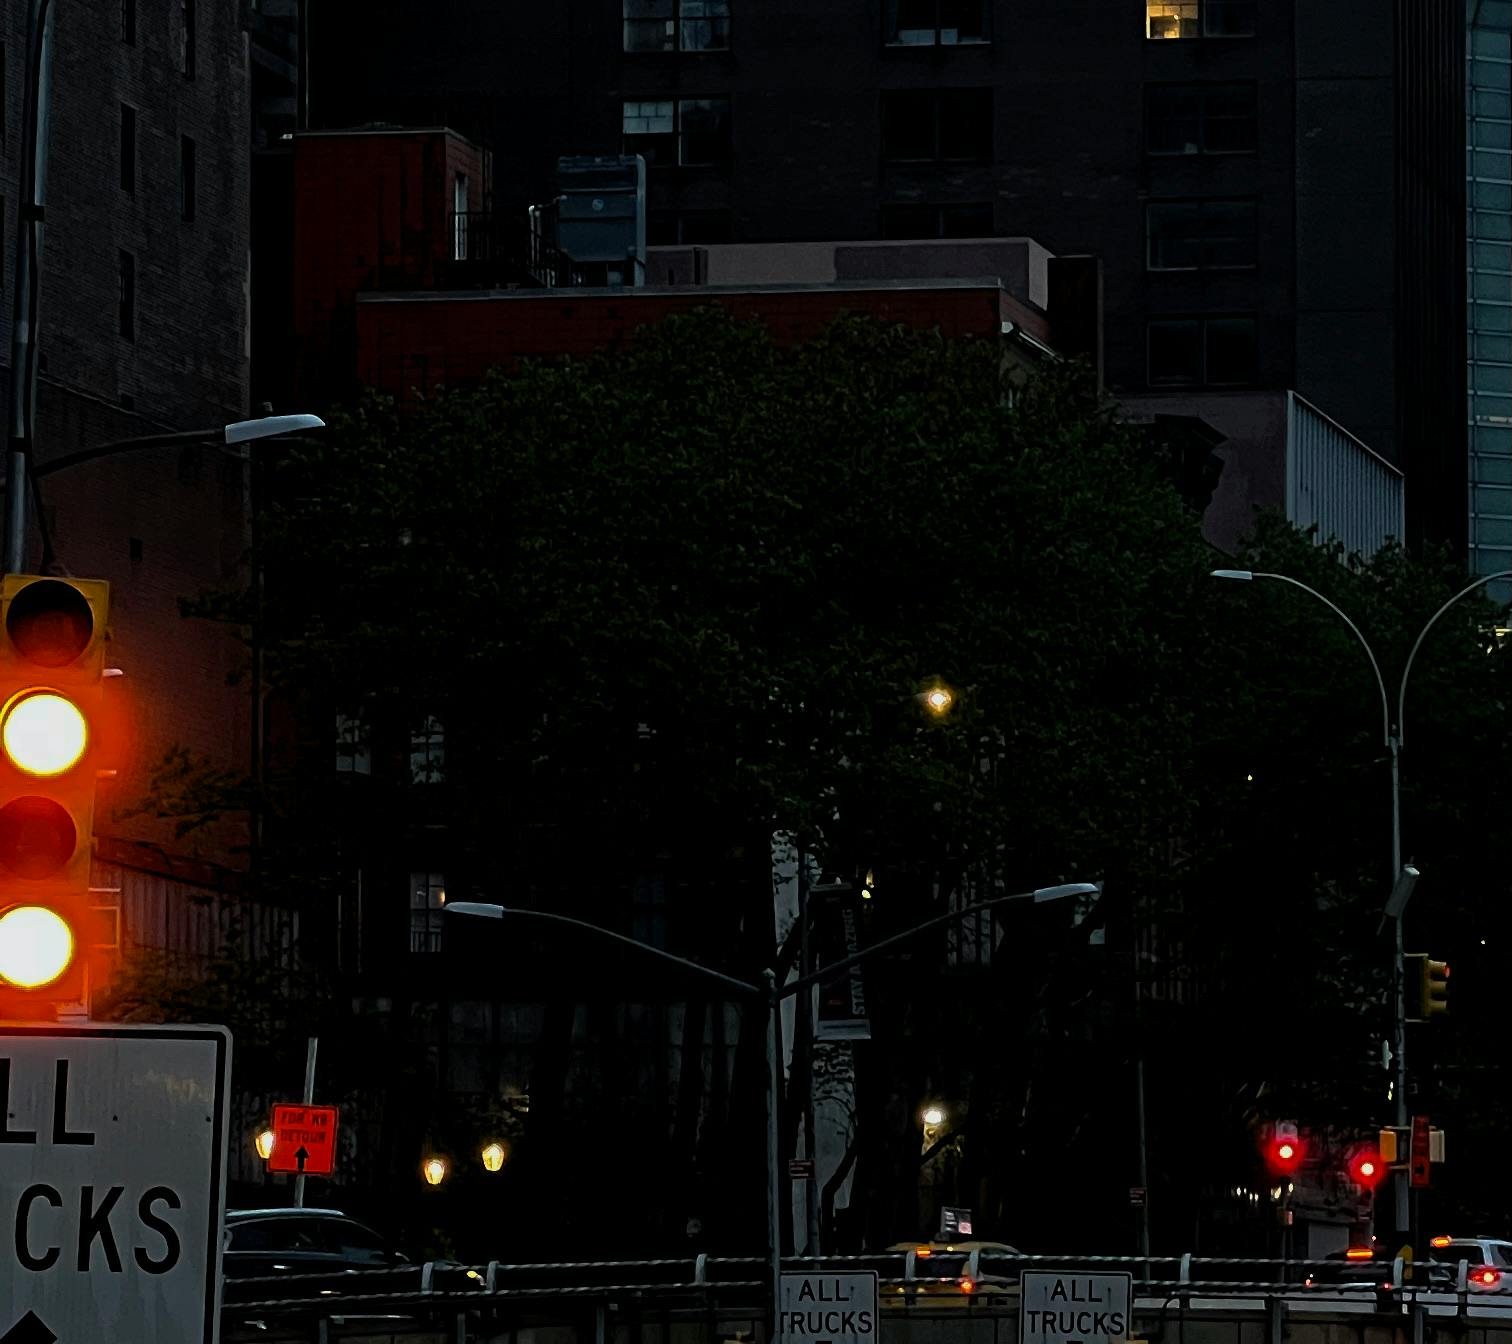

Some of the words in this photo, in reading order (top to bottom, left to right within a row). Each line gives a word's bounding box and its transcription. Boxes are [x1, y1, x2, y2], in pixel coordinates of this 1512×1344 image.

[15, 1183, 181, 1274] CKS
[799, 1280, 849, 1302] ALL
[1051, 1280, 1102, 1302] ALL
[781, 1311, 872, 1334] TRUCKS
[1027, 1311, 1124, 1335] TRUCKS
